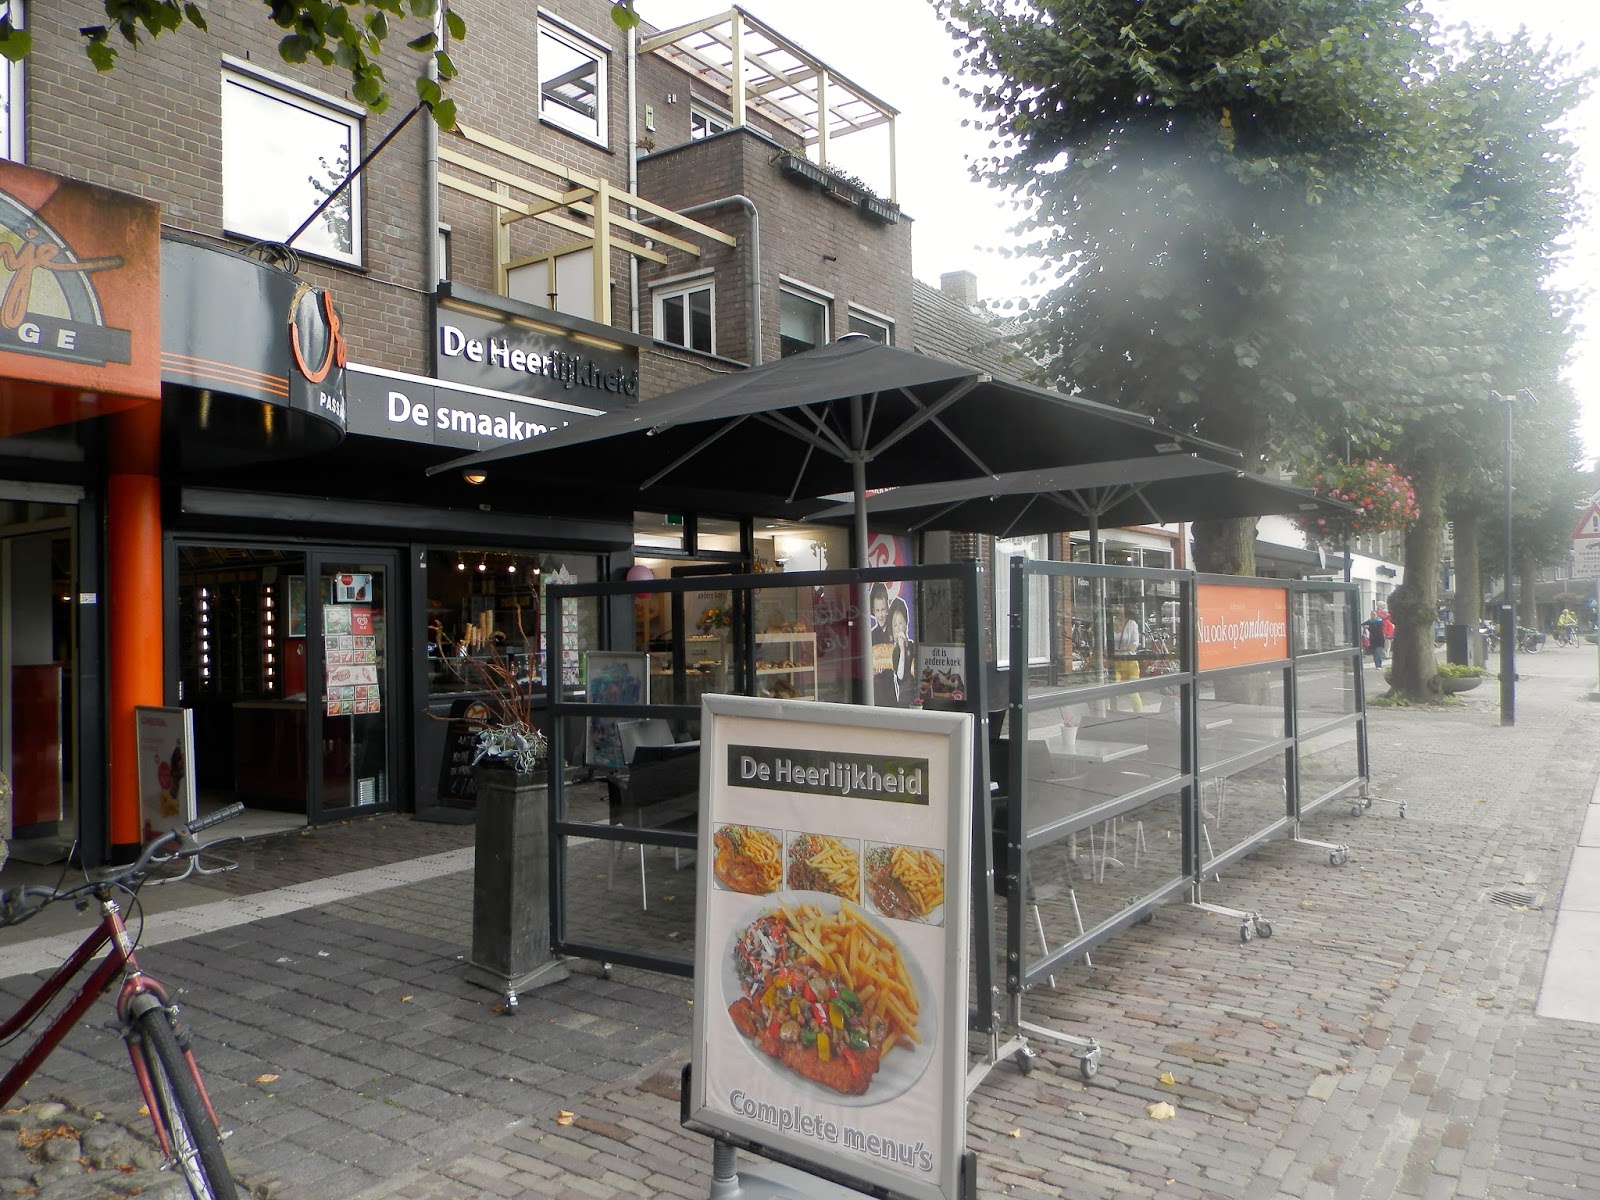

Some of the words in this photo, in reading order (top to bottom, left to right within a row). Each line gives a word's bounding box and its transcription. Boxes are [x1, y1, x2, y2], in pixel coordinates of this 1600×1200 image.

[441, 325, 484, 362] De
[490, 337, 639, 397] Heerlijkheid
[388, 391, 430, 427] De
[1197, 616, 1210, 643] Nu
[1210, 616, 1228, 642] ook
[1228, 623, 1239, 649] op
[1239, 611, 1269, 647] zondag
[1269, 621, 1286, 646] open
[924, 657, 946, 666] andere
[946, 657, 962, 667] koek
[931, 648, 941, 657] dit
[941, 648, 947, 657] is
[740, 756, 771, 781] De
[775, 758, 922, 796] Heerlijkheid
[729, 1089, 839, 1143] Complete
[843, 1125, 933, 1172] menu's
